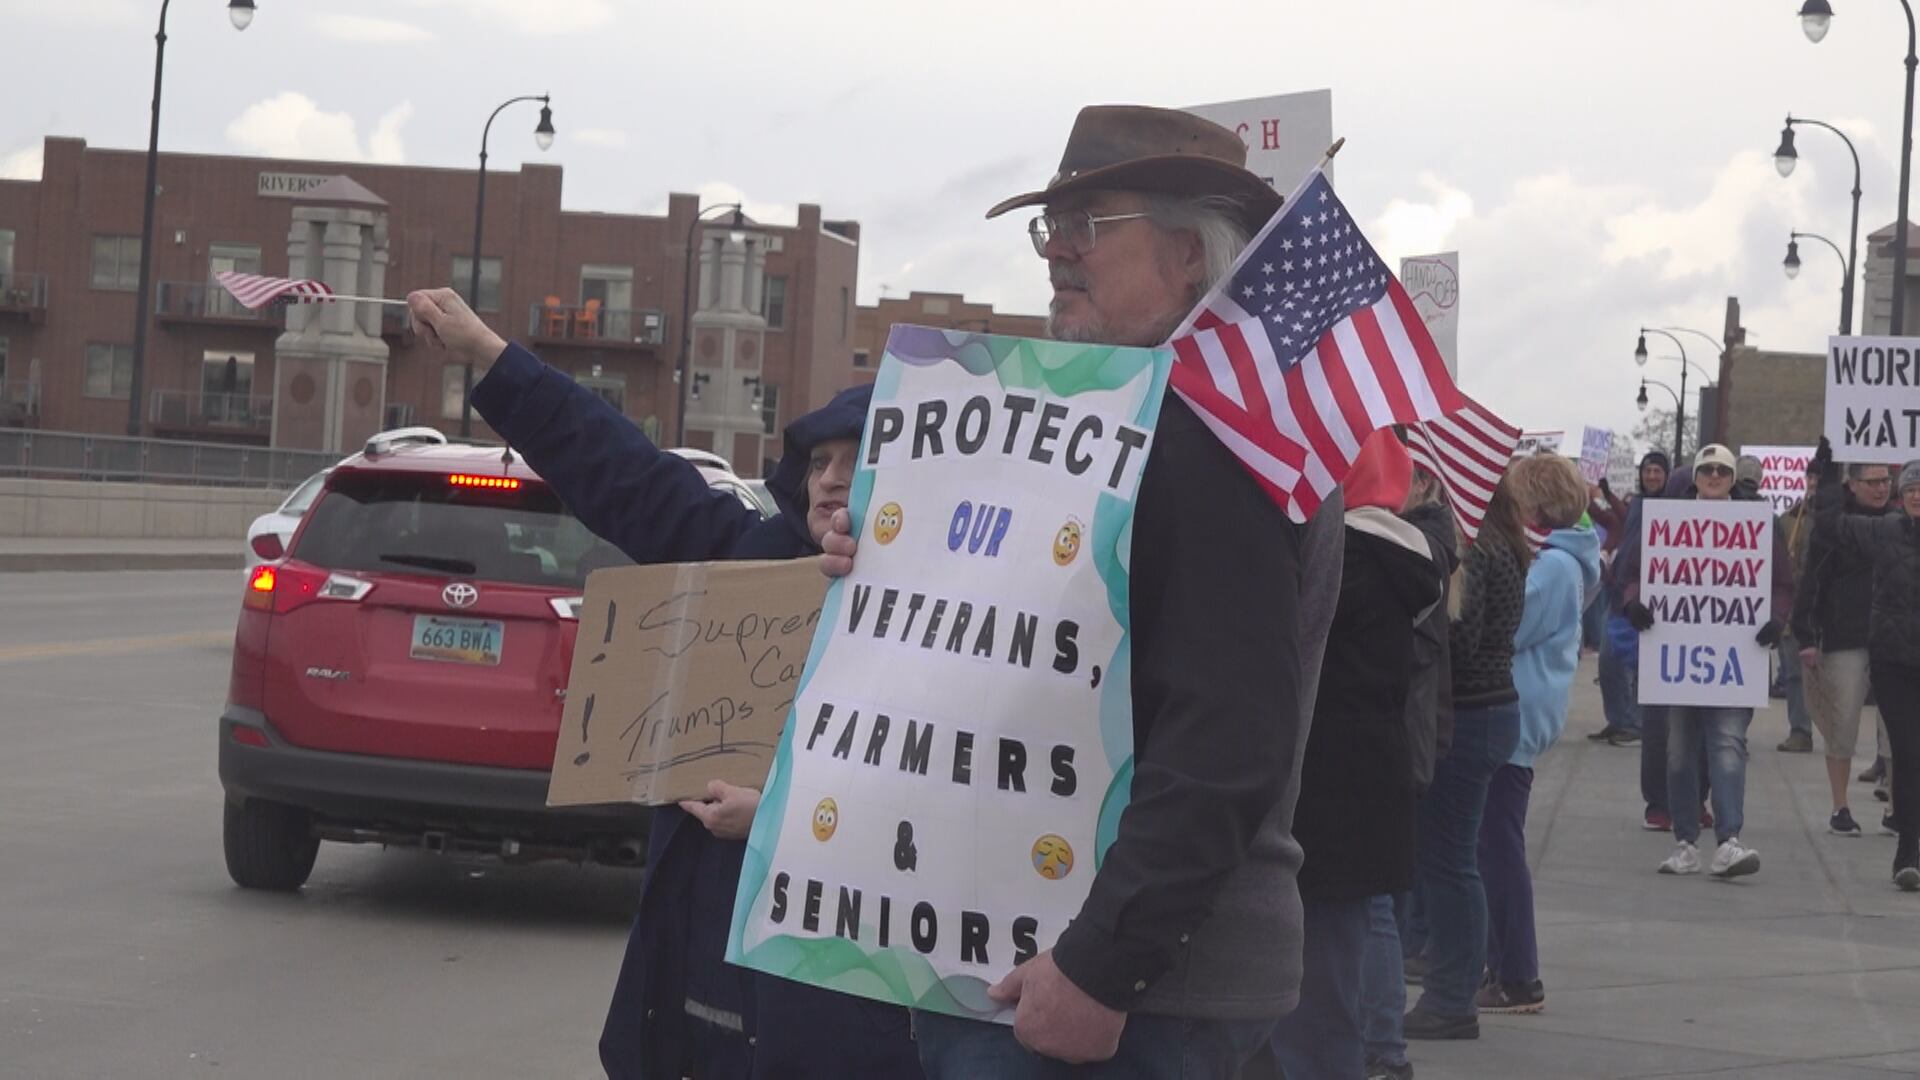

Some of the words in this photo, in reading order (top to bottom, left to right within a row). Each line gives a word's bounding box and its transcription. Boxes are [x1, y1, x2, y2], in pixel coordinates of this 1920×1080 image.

[260, 175, 328, 193] RIVERS
[867, 394, 1147, 489] PROTECT
[1760, 455, 1809, 472] AYDA
[1760, 475, 1805, 491] AYDA
[947, 500, 1012, 557] OUR
[1648, 519, 1766, 550] MAYDAY
[1648, 557, 1765, 588] MAYDAY
[1648, 595, 1765, 626] MAYDAY
[422, 628, 455, 648] 663
[460, 630, 492, 651] BWA
[848, 584, 1101, 689] VETERANS,
[1660, 644, 1744, 686] USA
[806, 702, 1077, 797] FARMERS
[894, 820, 918, 872] &
[770, 871, 1076, 966] SENIORS
